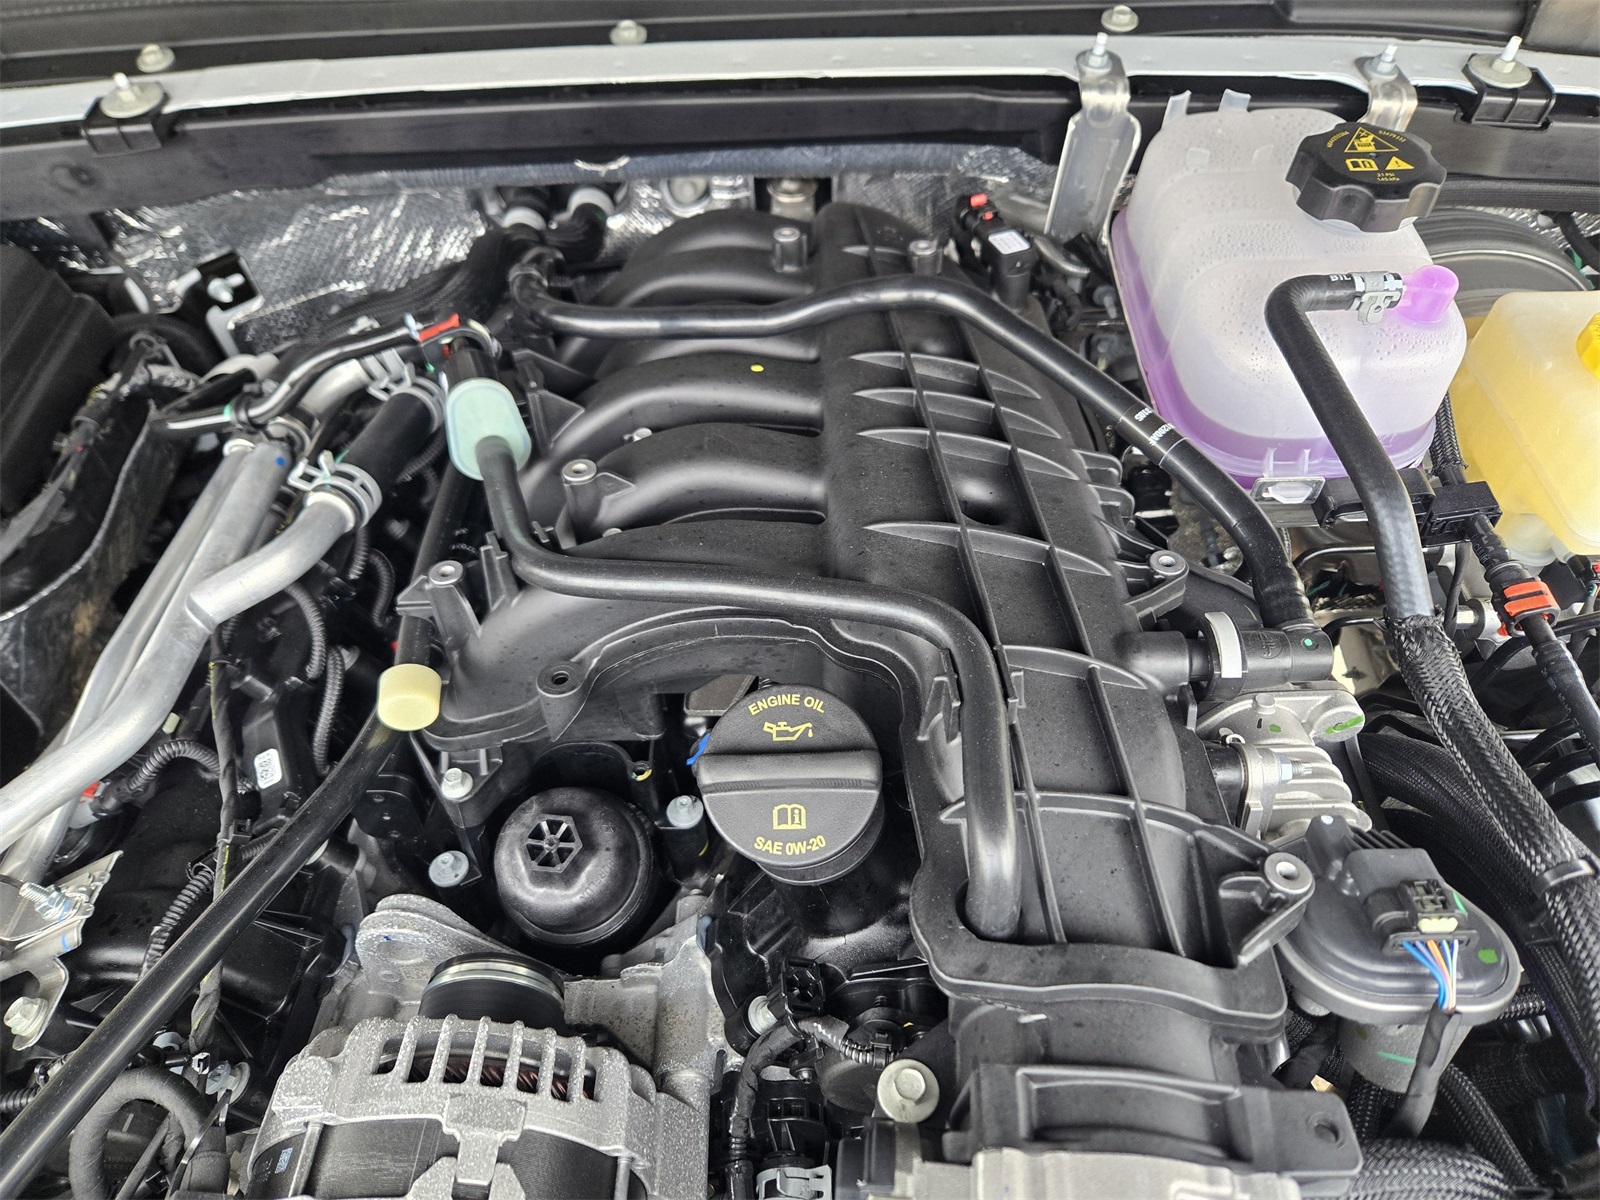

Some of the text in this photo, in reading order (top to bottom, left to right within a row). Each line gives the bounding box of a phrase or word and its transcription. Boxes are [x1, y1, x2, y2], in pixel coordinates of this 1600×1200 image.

[748, 694, 826, 716] ENGINE OIL
[754, 835, 826, 856] SAE 0W-20
[578, 858, 617, 901] PURFLUX
